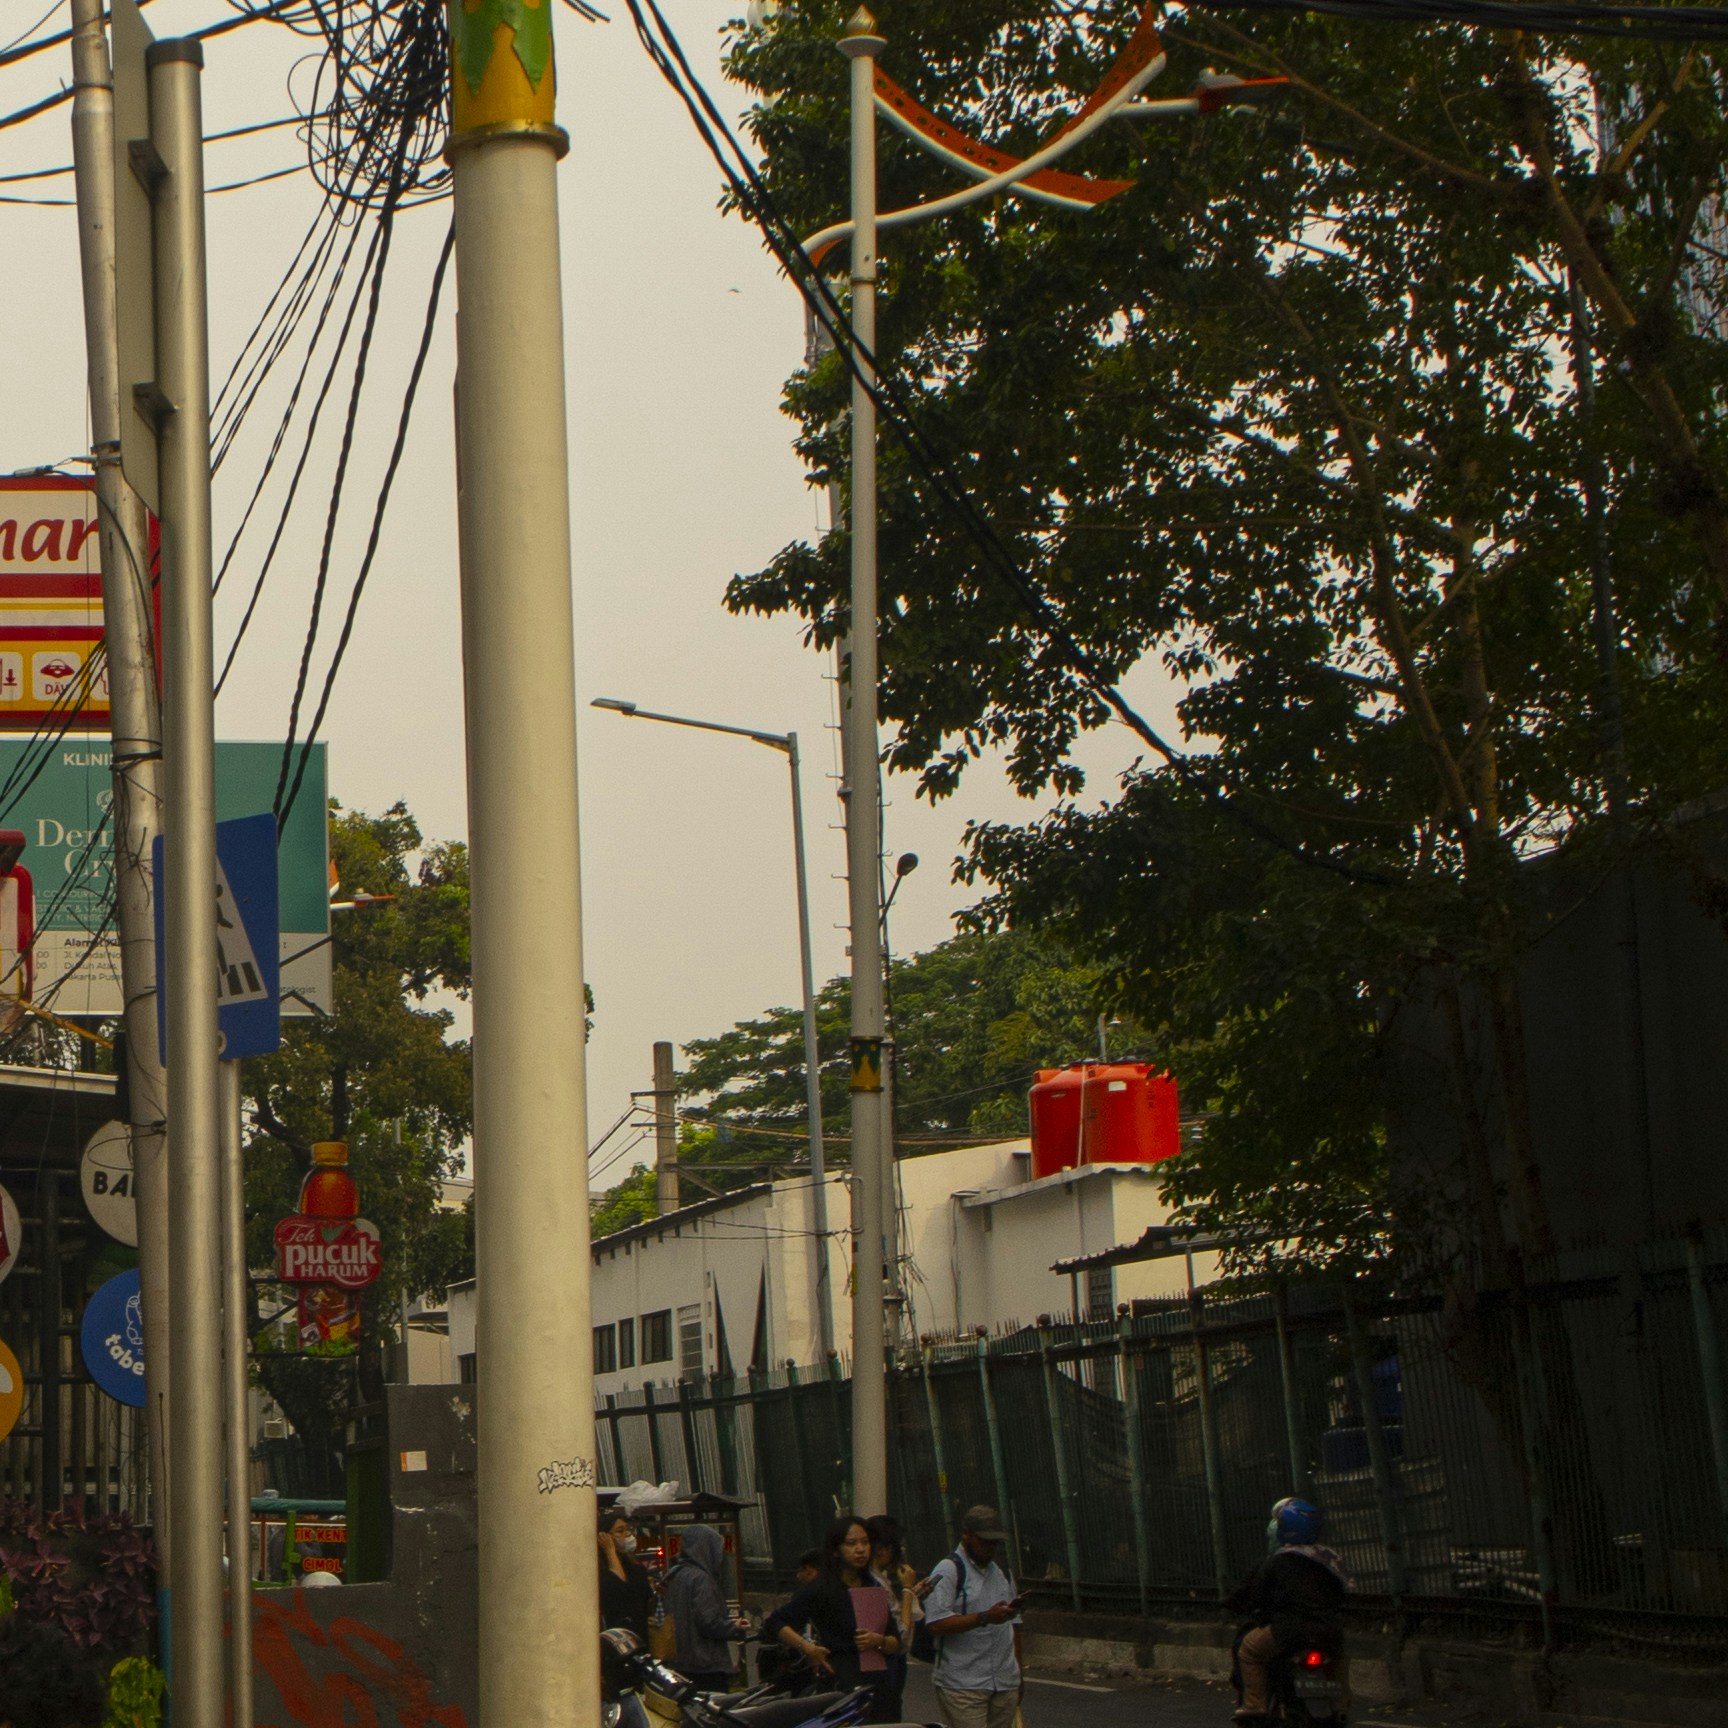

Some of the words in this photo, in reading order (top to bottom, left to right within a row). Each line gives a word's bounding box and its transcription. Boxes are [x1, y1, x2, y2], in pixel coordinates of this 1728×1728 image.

[63, 751, 114, 767] KLINI
[92, 1170, 137, 1198] BA
[285, 1236, 378, 1278] pucuk
[300, 1264, 369, 1285] HARUM
